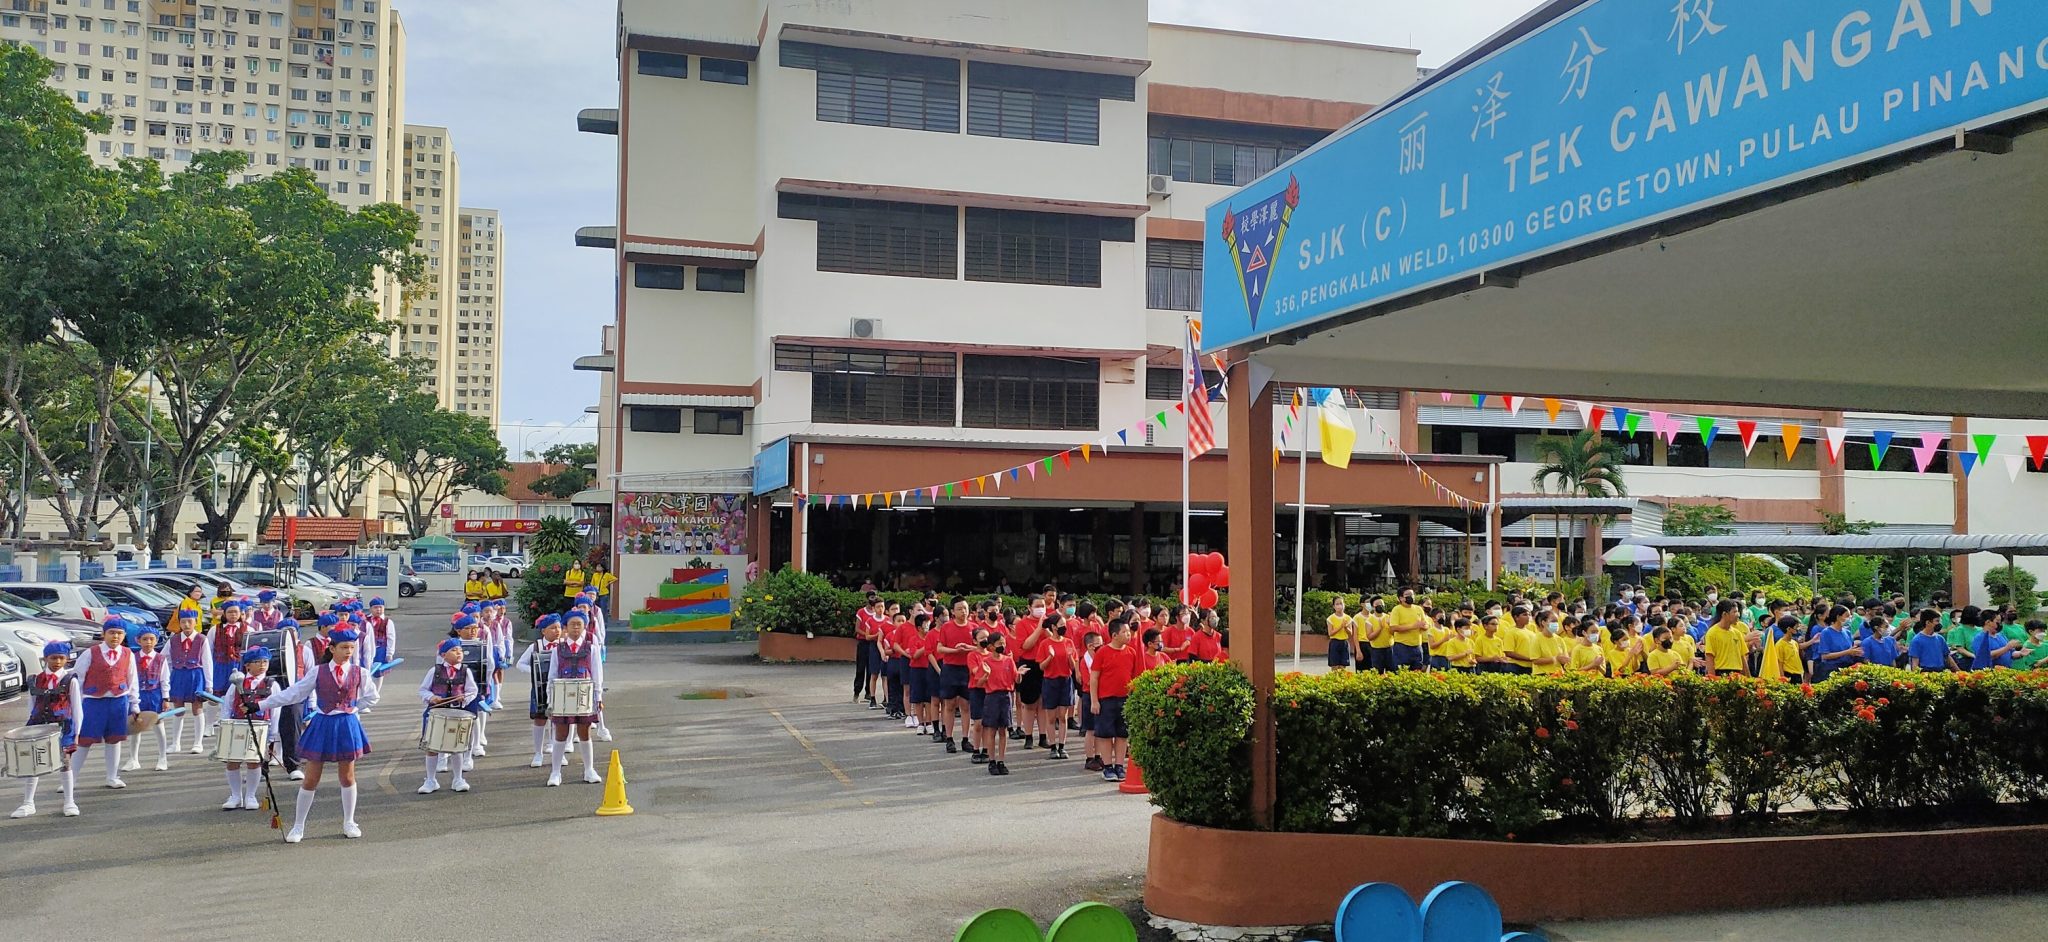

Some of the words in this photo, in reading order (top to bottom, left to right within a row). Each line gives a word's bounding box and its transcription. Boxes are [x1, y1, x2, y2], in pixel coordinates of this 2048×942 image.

[1298, 223, 1346, 270] SJK
[1439, 172, 1470, 219] LI
[1503, 124, 1585, 193] TEK
[635, 494, 709, 515] 仙人掌园
[639, 515, 678, 525] TAMAN
[681, 516, 727, 525] KAKTUS
